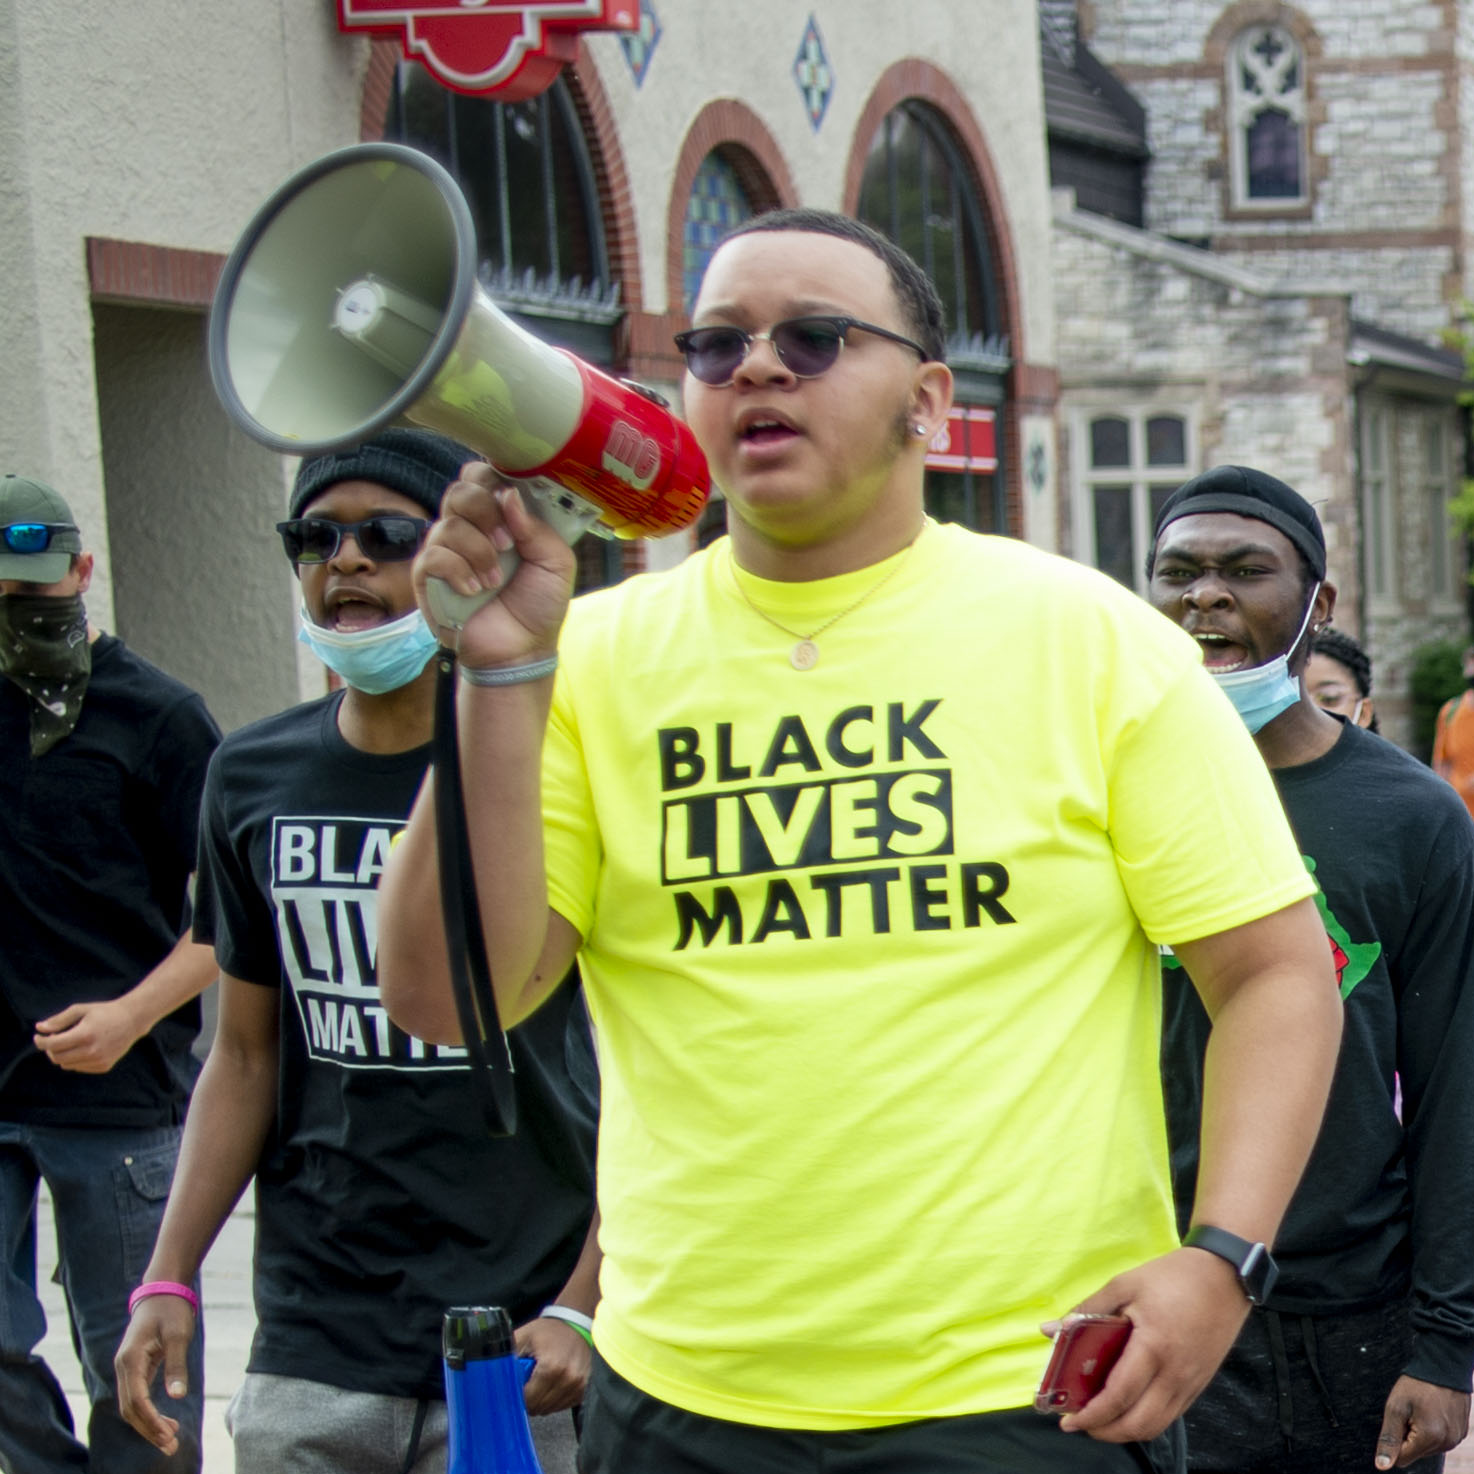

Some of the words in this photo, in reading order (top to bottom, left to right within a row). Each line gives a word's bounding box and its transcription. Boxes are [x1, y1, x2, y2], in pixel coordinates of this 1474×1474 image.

[657, 698, 949, 792] BLACK
[279, 825, 391, 884] BLA
[664, 772, 949, 881] LIVES
[673, 862, 1018, 952] MATTER
